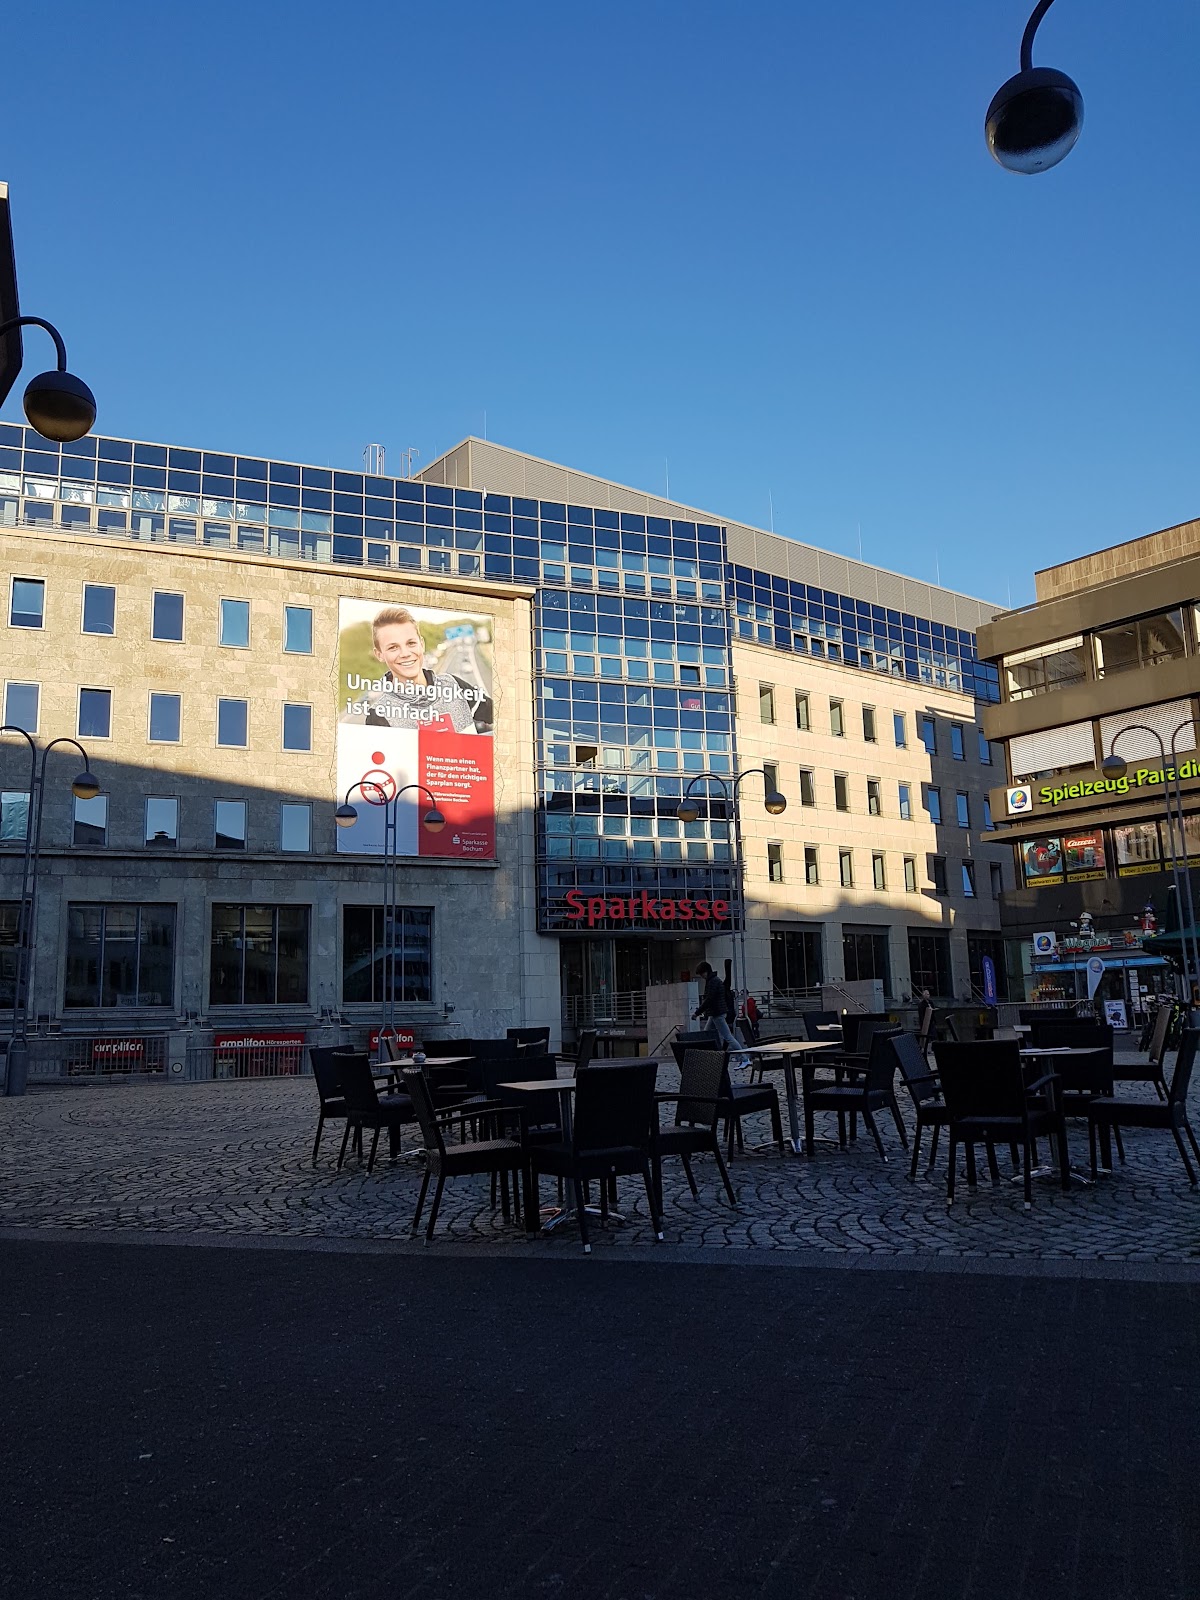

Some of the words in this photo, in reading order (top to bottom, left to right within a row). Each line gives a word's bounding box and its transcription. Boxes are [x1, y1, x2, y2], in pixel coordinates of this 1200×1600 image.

[347, 673, 487, 702] Unabhängigkeit
[346, 698, 371, 715] ist
[375, 701, 445, 722] einfach.
[426, 764, 468, 772] Finanzpartner
[426, 779, 453, 787] Sparplan
[454, 781, 472, 789] sorgt.
[1041, 758, 1200, 805] Spielzeug-Paradi
[566, 889, 729, 927] Sparkasse
[94, 1041, 144, 1055] amplifon
[220, 1038, 265, 1048] amplifon
